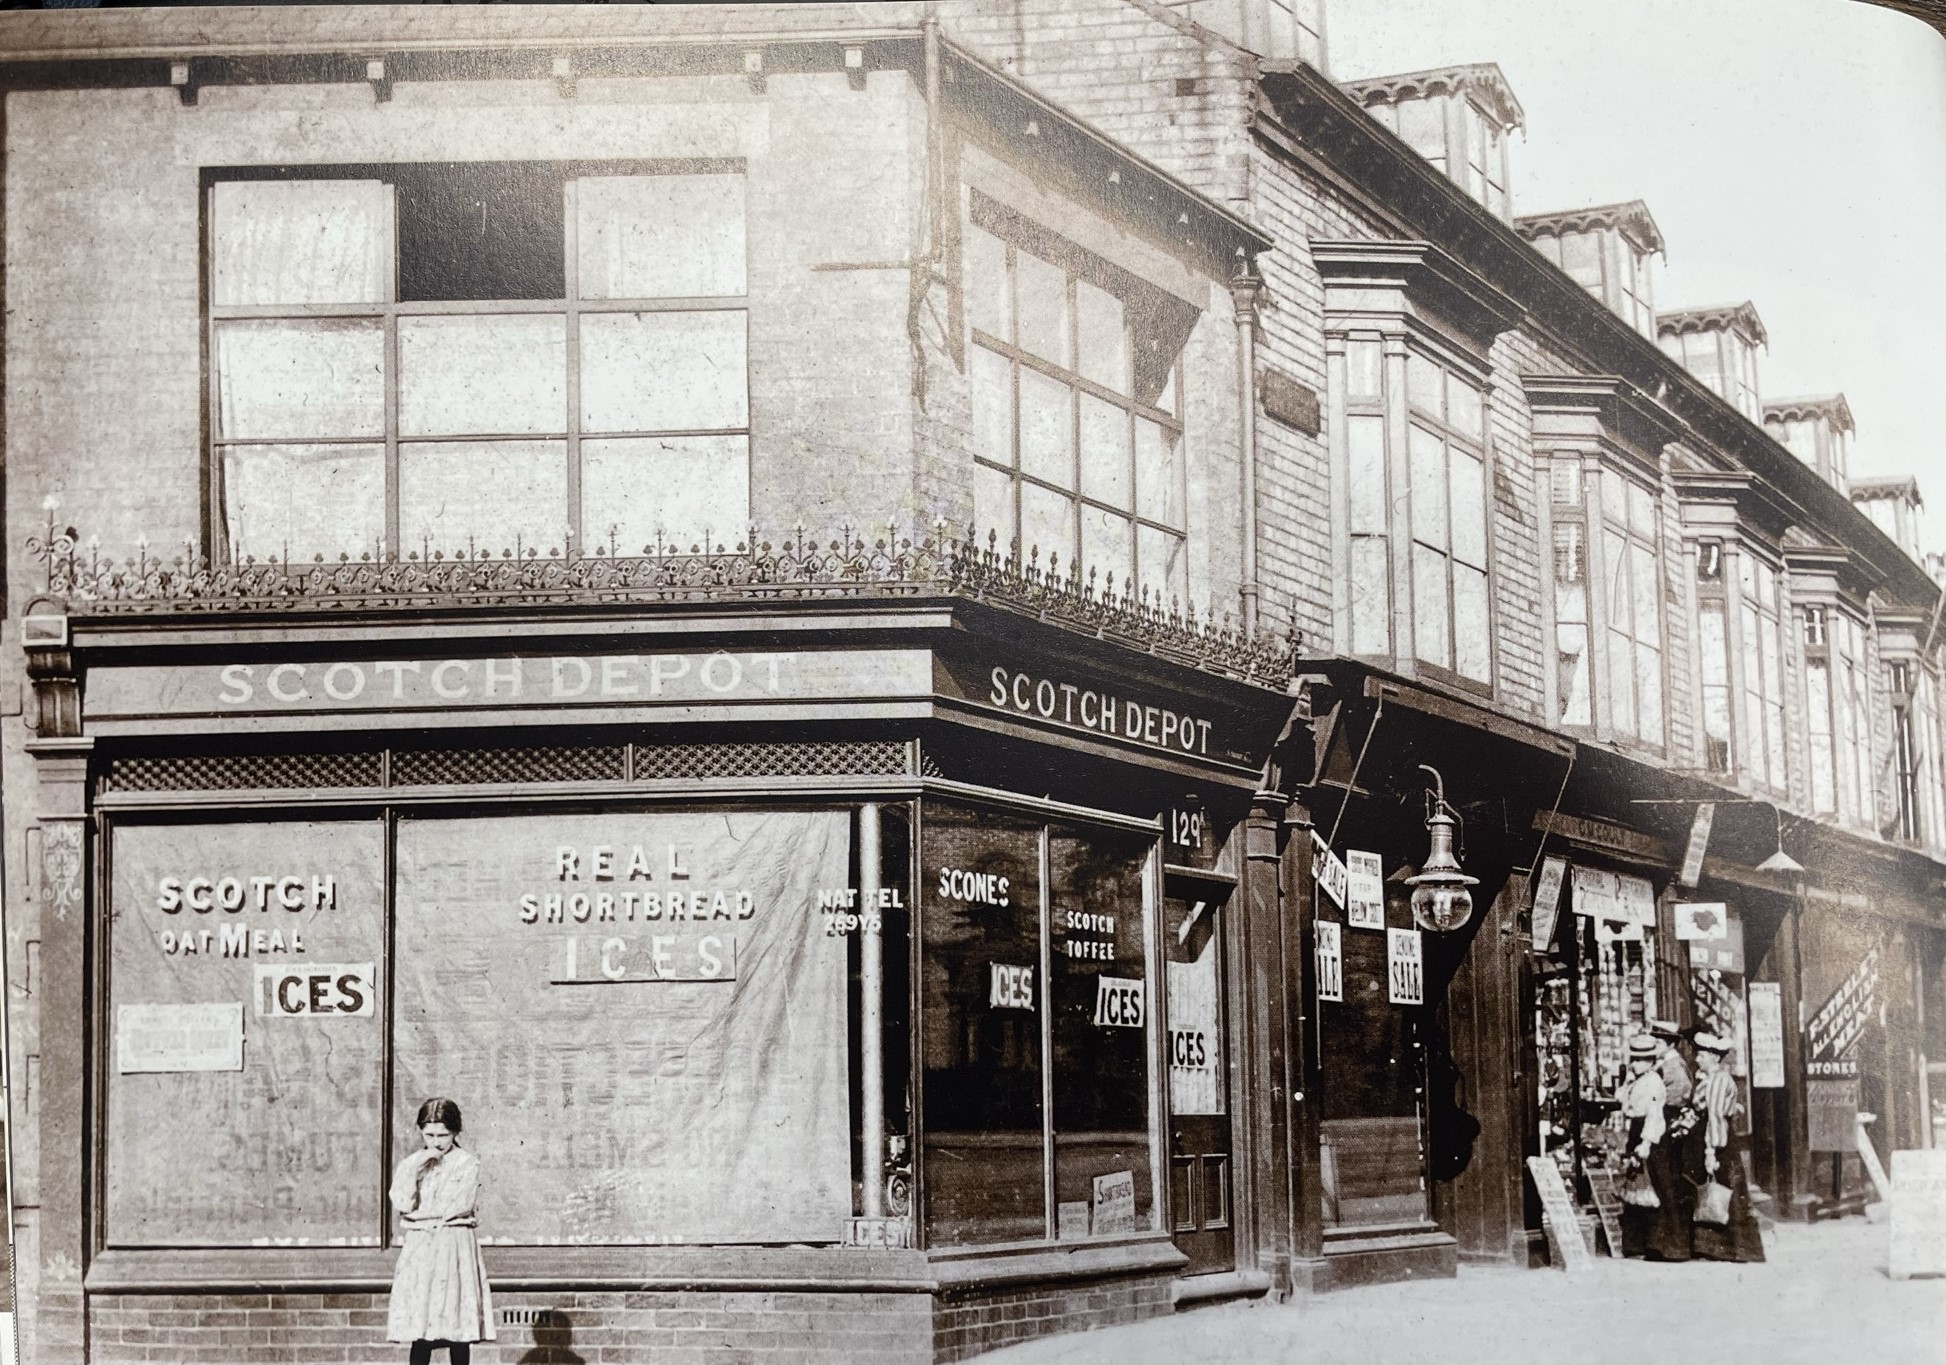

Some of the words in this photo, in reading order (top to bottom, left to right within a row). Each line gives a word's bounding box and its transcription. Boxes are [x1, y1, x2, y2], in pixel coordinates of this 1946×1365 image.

[219, 658, 523, 704] SCOTCH
[551, 652, 797, 698] DEPOT
[990, 666, 1116, 733] SCOTCH
[1126, 701, 1212, 754] DEPOT
[1172, 808, 1201, 848] 129
[556, 843, 692, 882] REAL
[157, 874, 337, 914] SCOTCH
[817, 888, 858, 913] NAT
[862, 888, 904, 908] TEL
[938, 867, 1009, 907] SCONES
[518, 890, 755, 925] SHORTBREAD
[1067, 910, 1114, 934] SCOTCH
[159, 922, 306, 958] OATMEAL
[566, 935, 723, 980] ICES
[1067, 940, 1114, 960] TOFFEE
[263, 974, 364, 1014] ICES
[991, 963, 1033, 1007] ICES
[1393, 961, 1420, 1000] SALE
[1101, 988, 1140, 1024] ICES
[1807, 1062, 1857, 1075] STORES
